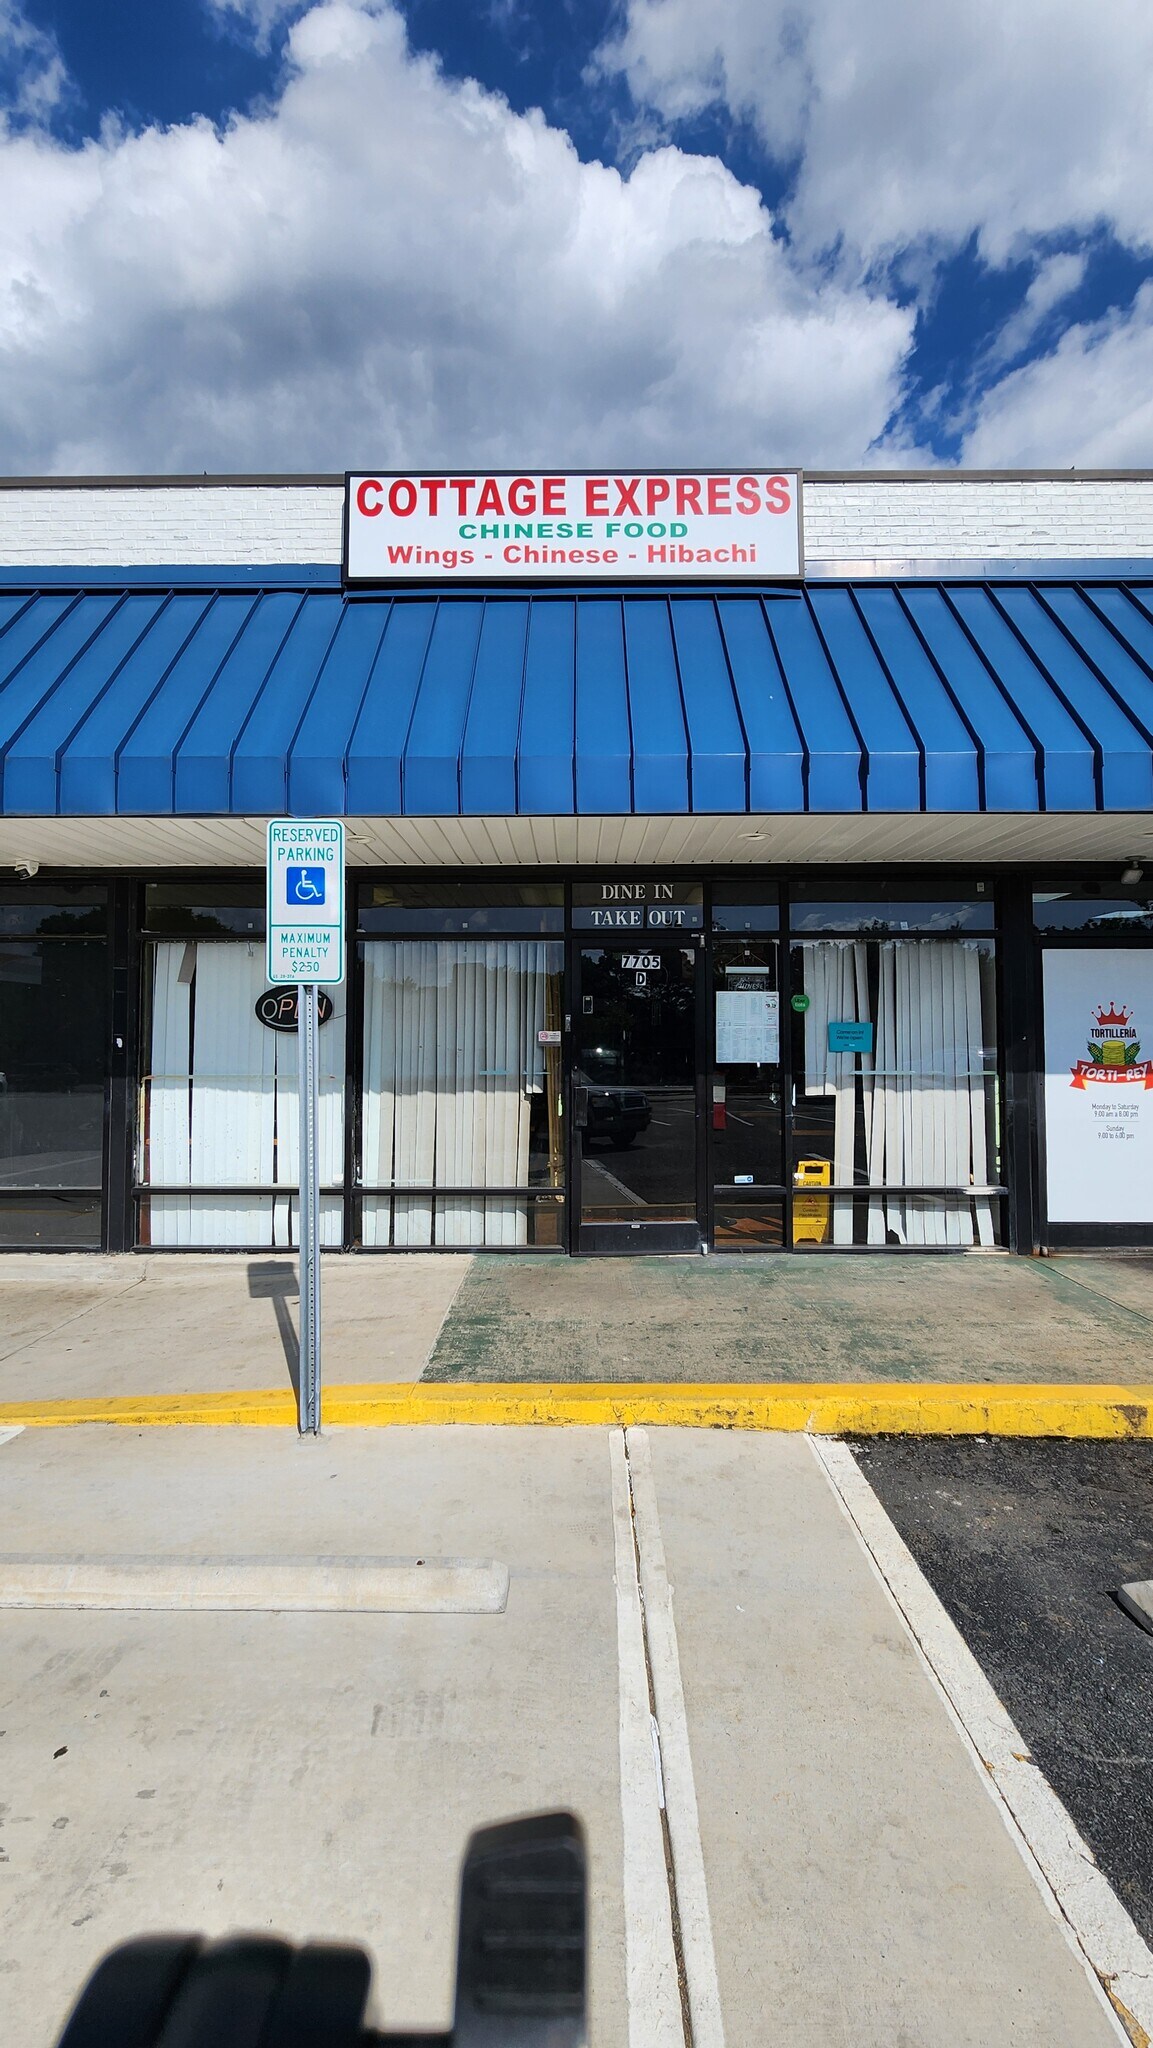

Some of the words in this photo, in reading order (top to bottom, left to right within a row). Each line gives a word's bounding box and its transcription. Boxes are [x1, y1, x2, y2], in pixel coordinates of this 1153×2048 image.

[356, 478, 567, 517] COTTAGE
[585, 475, 792, 516] EXPRESS
[458, 523, 594, 539] CHINESE
[606, 522, 689, 538] FOOD
[387, 545, 475, 569] Wings
[503, 545, 619, 564] Chinese
[647, 544, 757, 564] Hibachi
[273, 828, 339, 842] RESERVED
[277, 847, 334, 861] PARKING
[601, 884, 646, 899] DINE
[654, 884, 674, 899] IN
[591, 910, 641, 926] TAKE
[648, 910, 686, 926] OUT
[280, 933, 331, 944] MAXIMUM
[282, 947, 329, 958] PENALTY
[291, 961, 320, 973] $250
[622, 955, 660, 969] 7705
[636, 972, 646, 985] D
[261, 998, 327, 1019] OPN
[1090, 1026, 1137, 1039] TORTILLERÍA
[1080, 1064, 1148, 1082] TORTI-REY
[1091, 1103, 1111, 1111] Monday
[1118, 1103, 1139, 1111] Saturday
